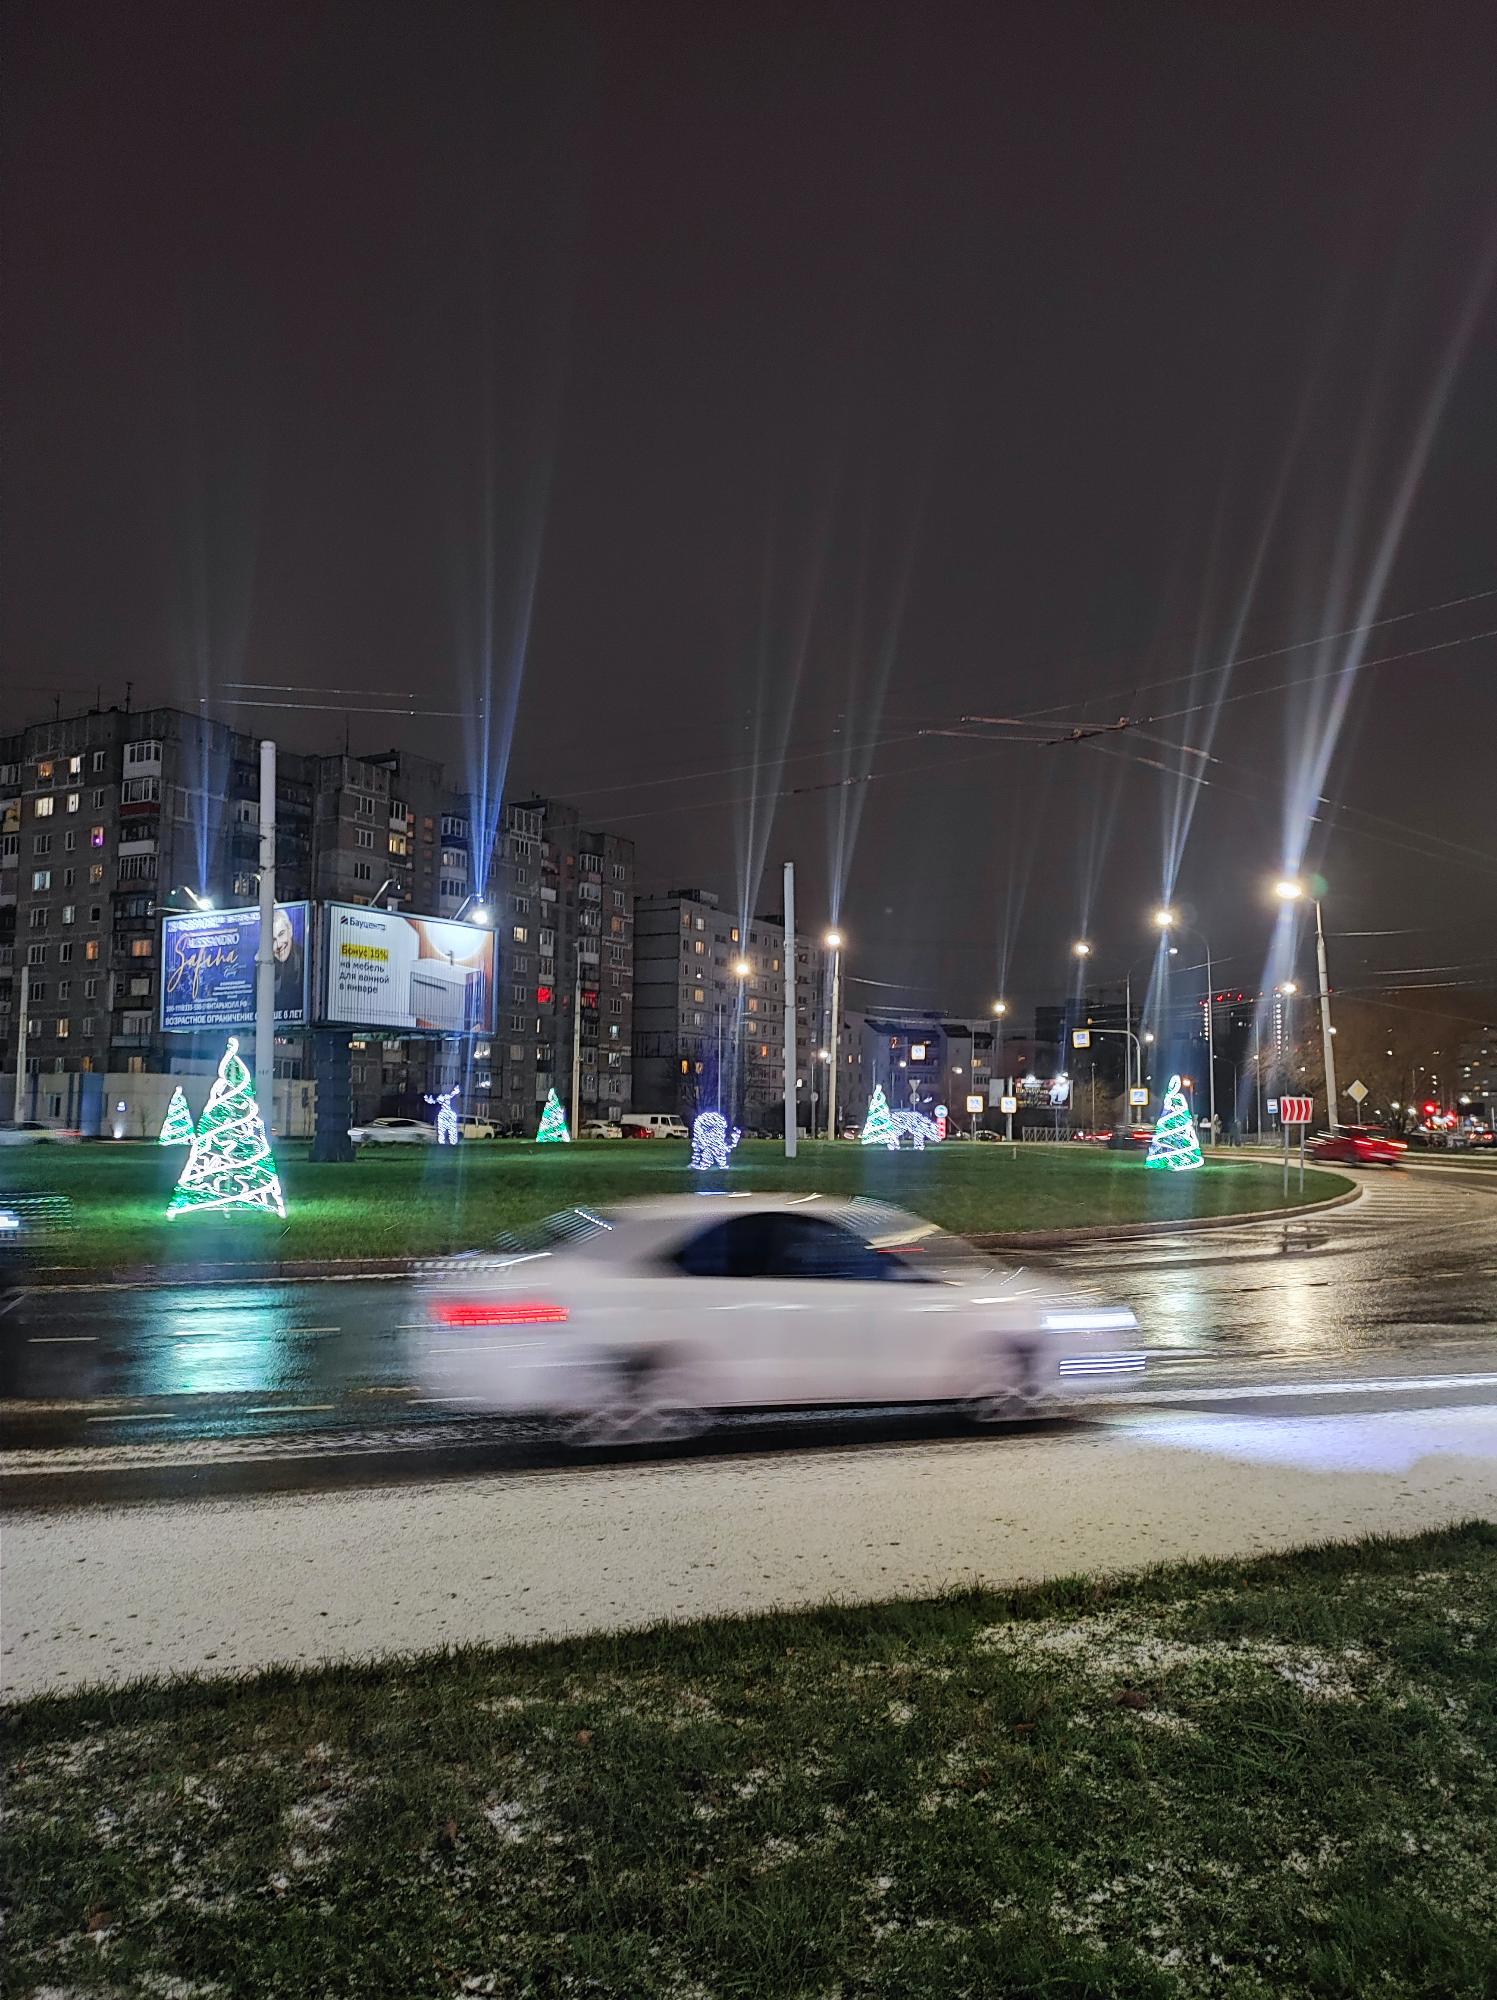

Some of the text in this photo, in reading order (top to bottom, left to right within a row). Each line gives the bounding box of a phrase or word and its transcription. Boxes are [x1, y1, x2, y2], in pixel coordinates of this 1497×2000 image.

[342, 944, 388, 960] Бонус 15%
[340, 961, 385, 973] на мебель
[339, 971, 390, 984] для ванной
[339, 983, 378, 995] в январе
[165, 1015, 206, 1026] ВОЗРАСТНОЕ
[206, 1012, 253, 1025] ОГРАНИЧЕНИЕ
[289, 1009, 303, 1019] ЛЕТ
